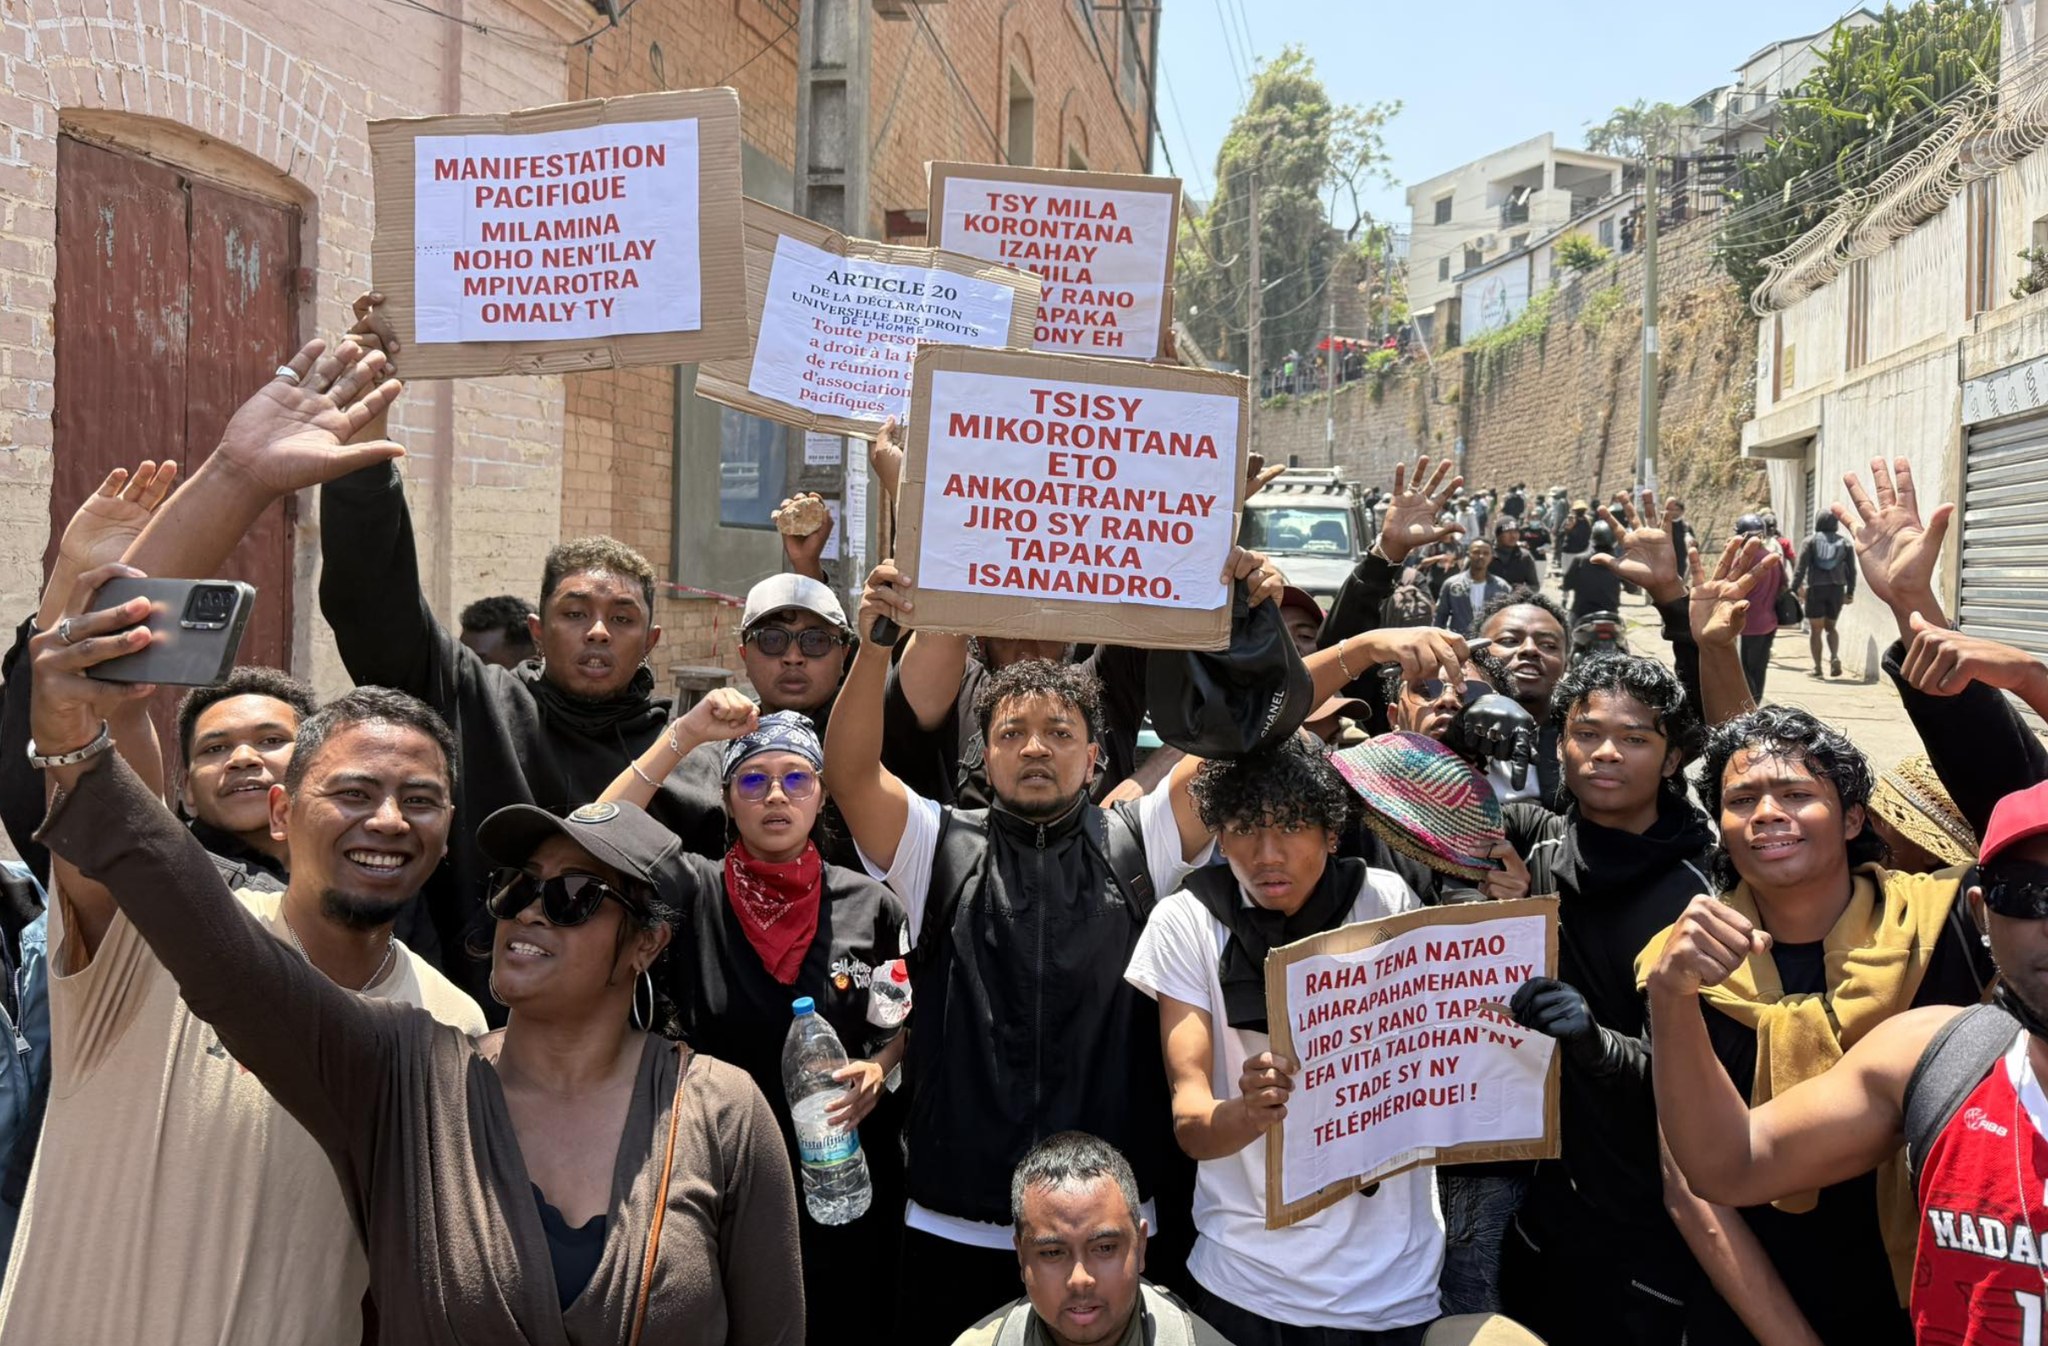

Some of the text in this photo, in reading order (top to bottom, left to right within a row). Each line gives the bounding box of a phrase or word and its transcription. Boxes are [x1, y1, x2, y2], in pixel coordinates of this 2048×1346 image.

[434, 144, 666, 181] MANIFESTATION
[475, 175, 626, 208] PACIFIQUE
[986, 193, 1118, 220] TSY MILA
[482, 214, 620, 242] MILAMINA
[964, 214, 1134, 244] KORONTANA
[453, 250, 533, 271] NOHO
[999, 240, 1098, 263] IZAHAY
[464, 268, 639, 296] MPIVAROTRA
[826, 270, 958, 301] ARTICLE 20
[1028, 263, 1093, 285] MILA
[810, 284, 830, 299] DE
[834, 292, 851, 303] LA
[1062, 289, 1135, 308] RANO
[481, 298, 615, 323] OMALY TY
[792, 291, 979, 337] UNIVERSELLE DES DROITS
[842, 316, 859, 326] DE
[1036, 306, 1118, 328] APAKA
[812, 317, 862, 339] Toute
[1093, 330, 1123, 348] EH
[809, 337, 819, 348] a
[823, 341, 868, 357] droit
[870, 347, 880, 359] à
[885, 348, 900, 361] la
[806, 353, 826, 368] de
[830, 360, 899, 379] réunion
[798, 387, 885, 412] pacifiques
[1030, 389, 1143, 422] TSISY
[948, 413, 1218, 459] MIKORONTANA
[1048, 452, 1117, 481] ETO
[963, 505, 1194, 545] JIRO SY RANO
[1005, 537, 1142, 569] TAPAKA
[968, 563, 1180, 600] ISANANDRO.
[1261, 690, 1285, 738] CHANEL
[1306, 935, 1506, 996] RAHA TENA NATAO
[1505, 965, 1533, 983] NY
[1305, 1030, 1342, 1061] JIRO
[1350, 1021, 1374, 1044] SY
[1378, 1004, 1427, 1034] RANO
[1305, 1066, 1335, 1090] EFA
[1342, 1048, 1381, 1075] VITA
[1335, 1056, 1460, 1107] STADE SY NY
[1928, 1209, 2048, 1267] MADA
